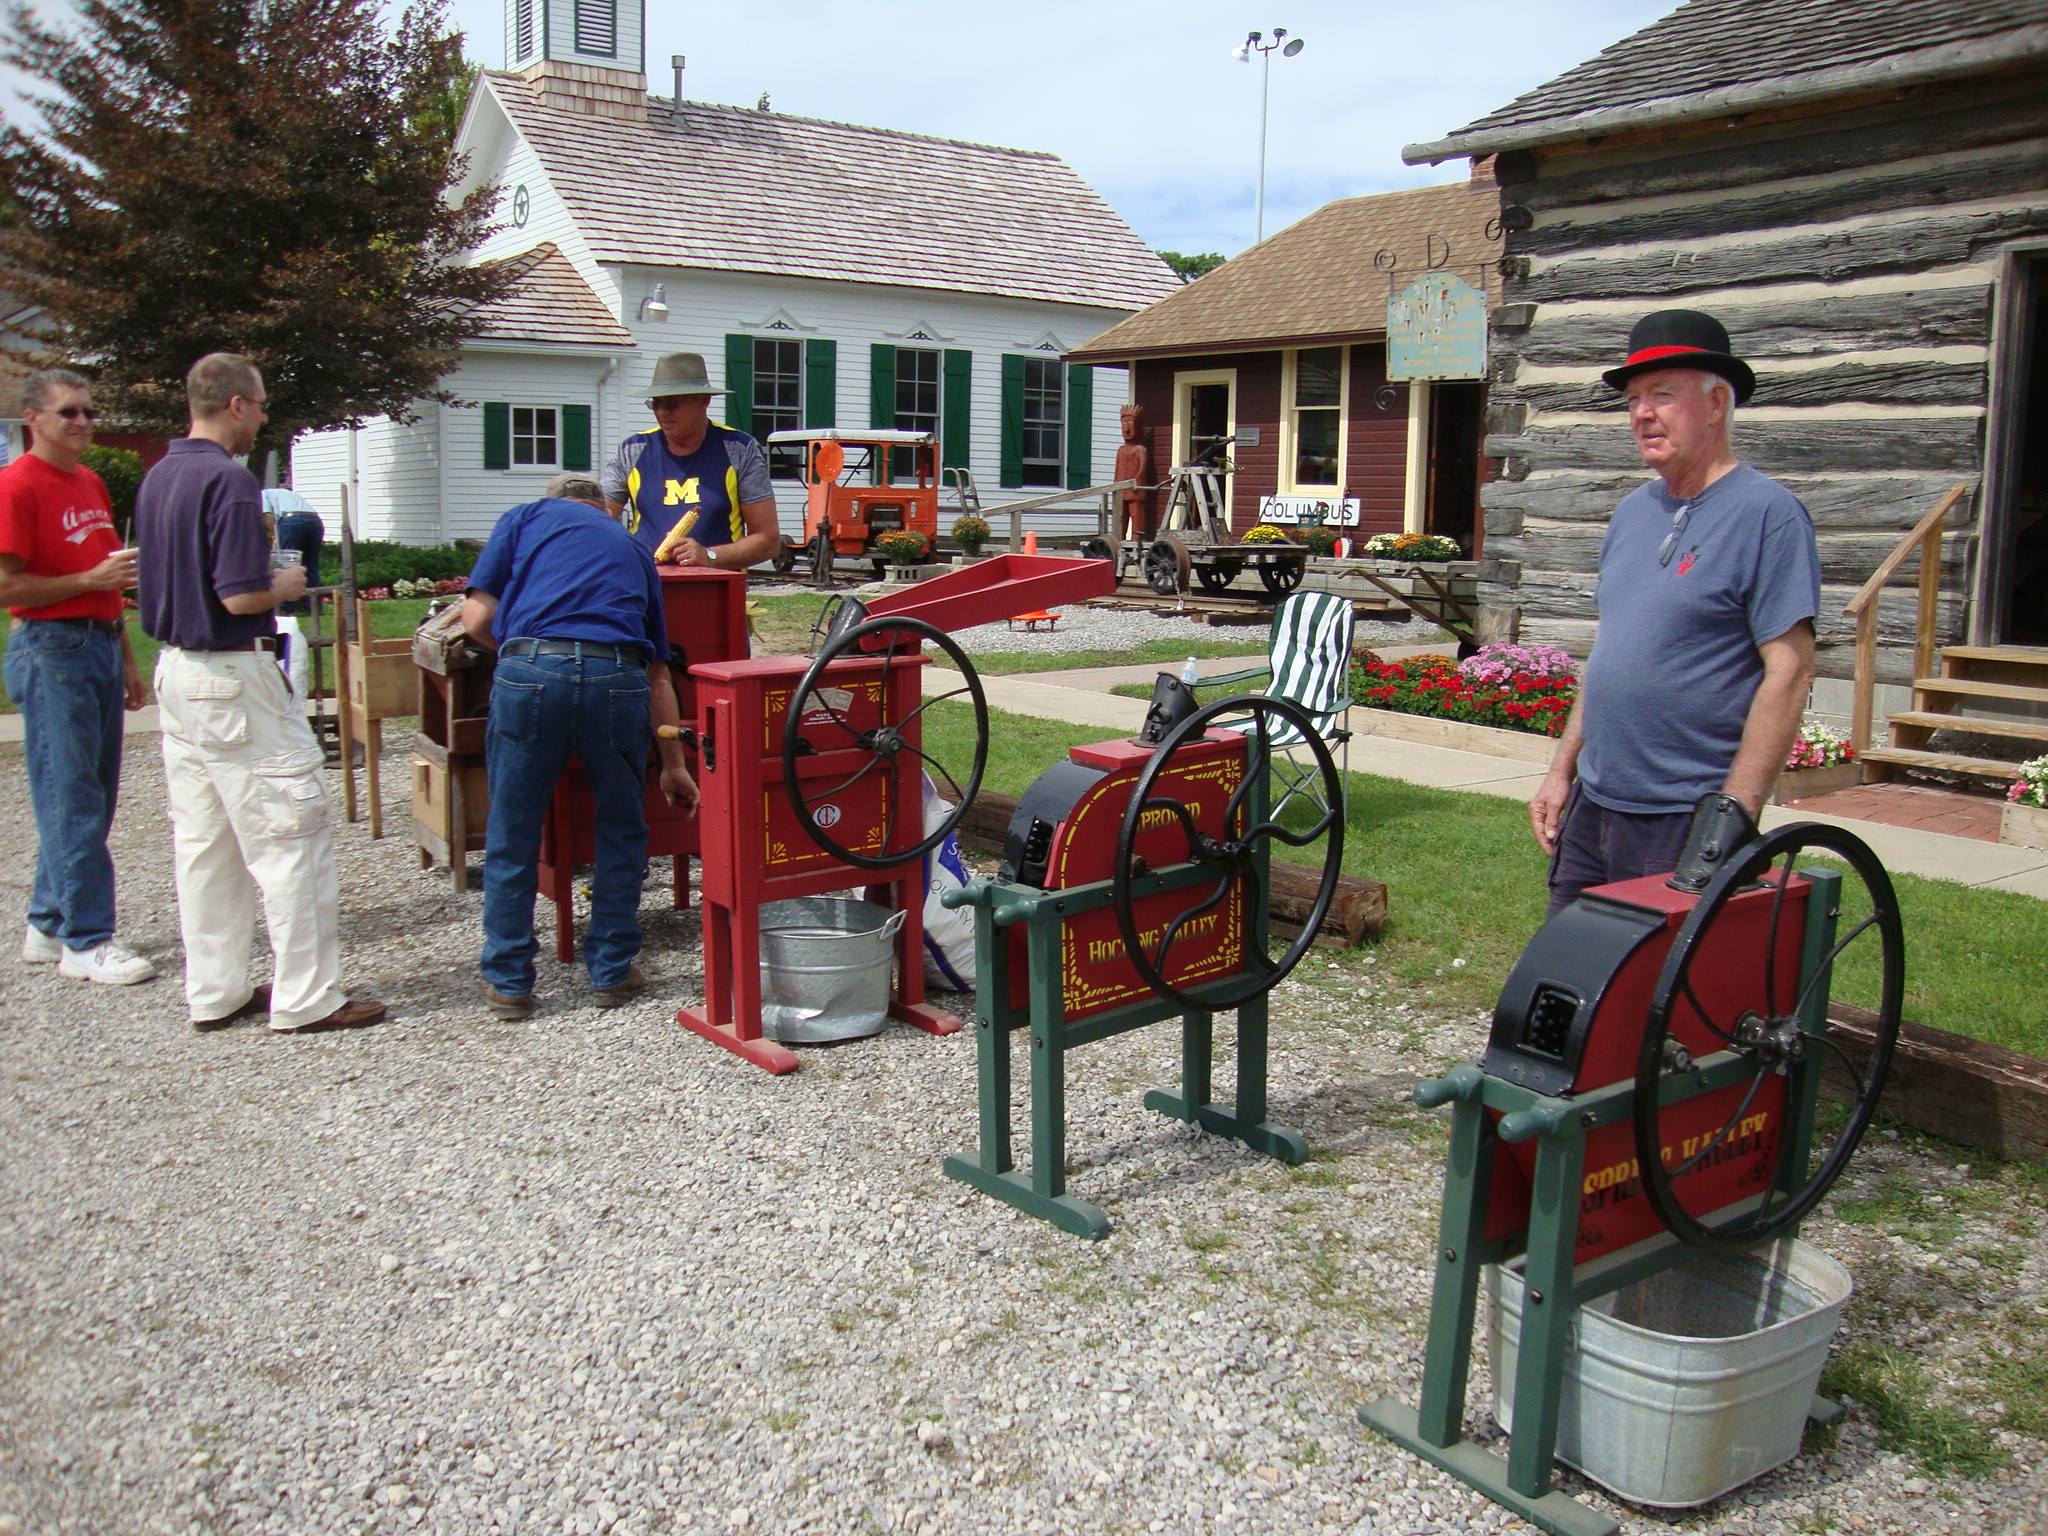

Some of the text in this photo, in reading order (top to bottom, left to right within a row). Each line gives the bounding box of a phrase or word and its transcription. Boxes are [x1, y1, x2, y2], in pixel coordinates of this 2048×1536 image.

[663, 477, 701, 506] M
[1263, 502, 1354, 520] COLUMBUS
[1088, 929, 1160, 964] HOCNG
